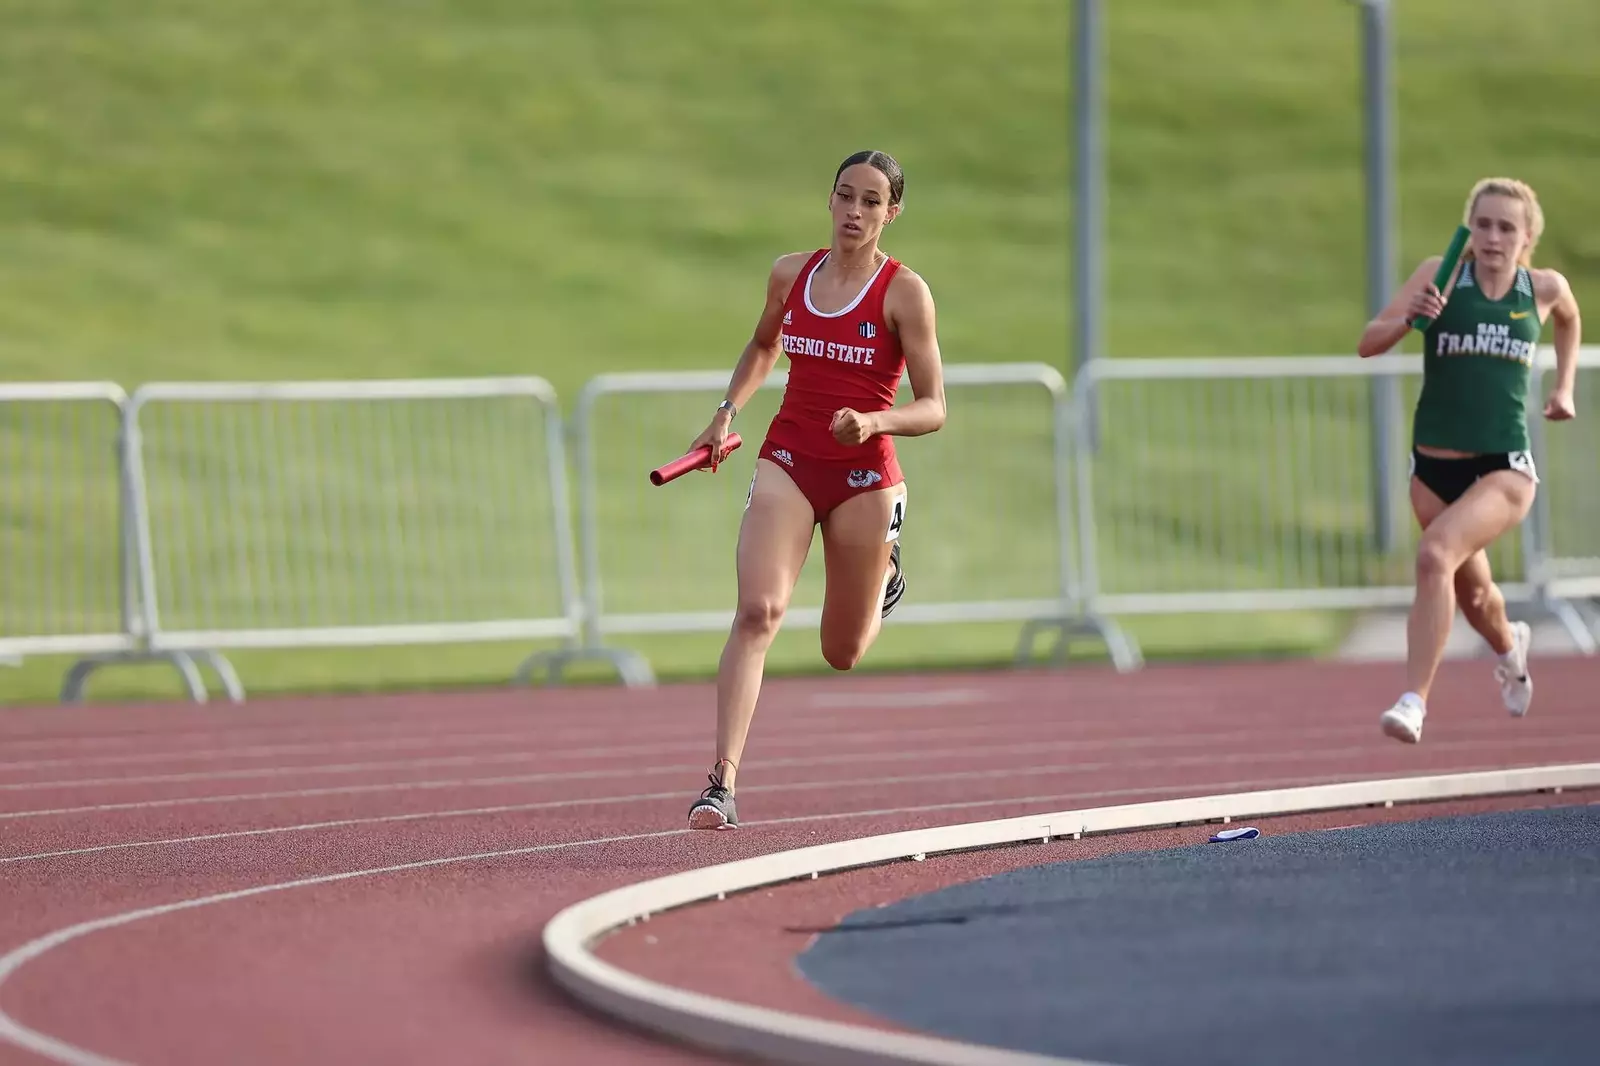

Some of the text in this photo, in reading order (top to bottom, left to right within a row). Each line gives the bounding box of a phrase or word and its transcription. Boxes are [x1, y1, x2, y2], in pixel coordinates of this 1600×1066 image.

[1477, 323, 1509, 336] SAN
[782, 334, 875, 365] RESNO STATE
[772, 450, 794, 467] adidas
[890, 502, 902, 532] 4
